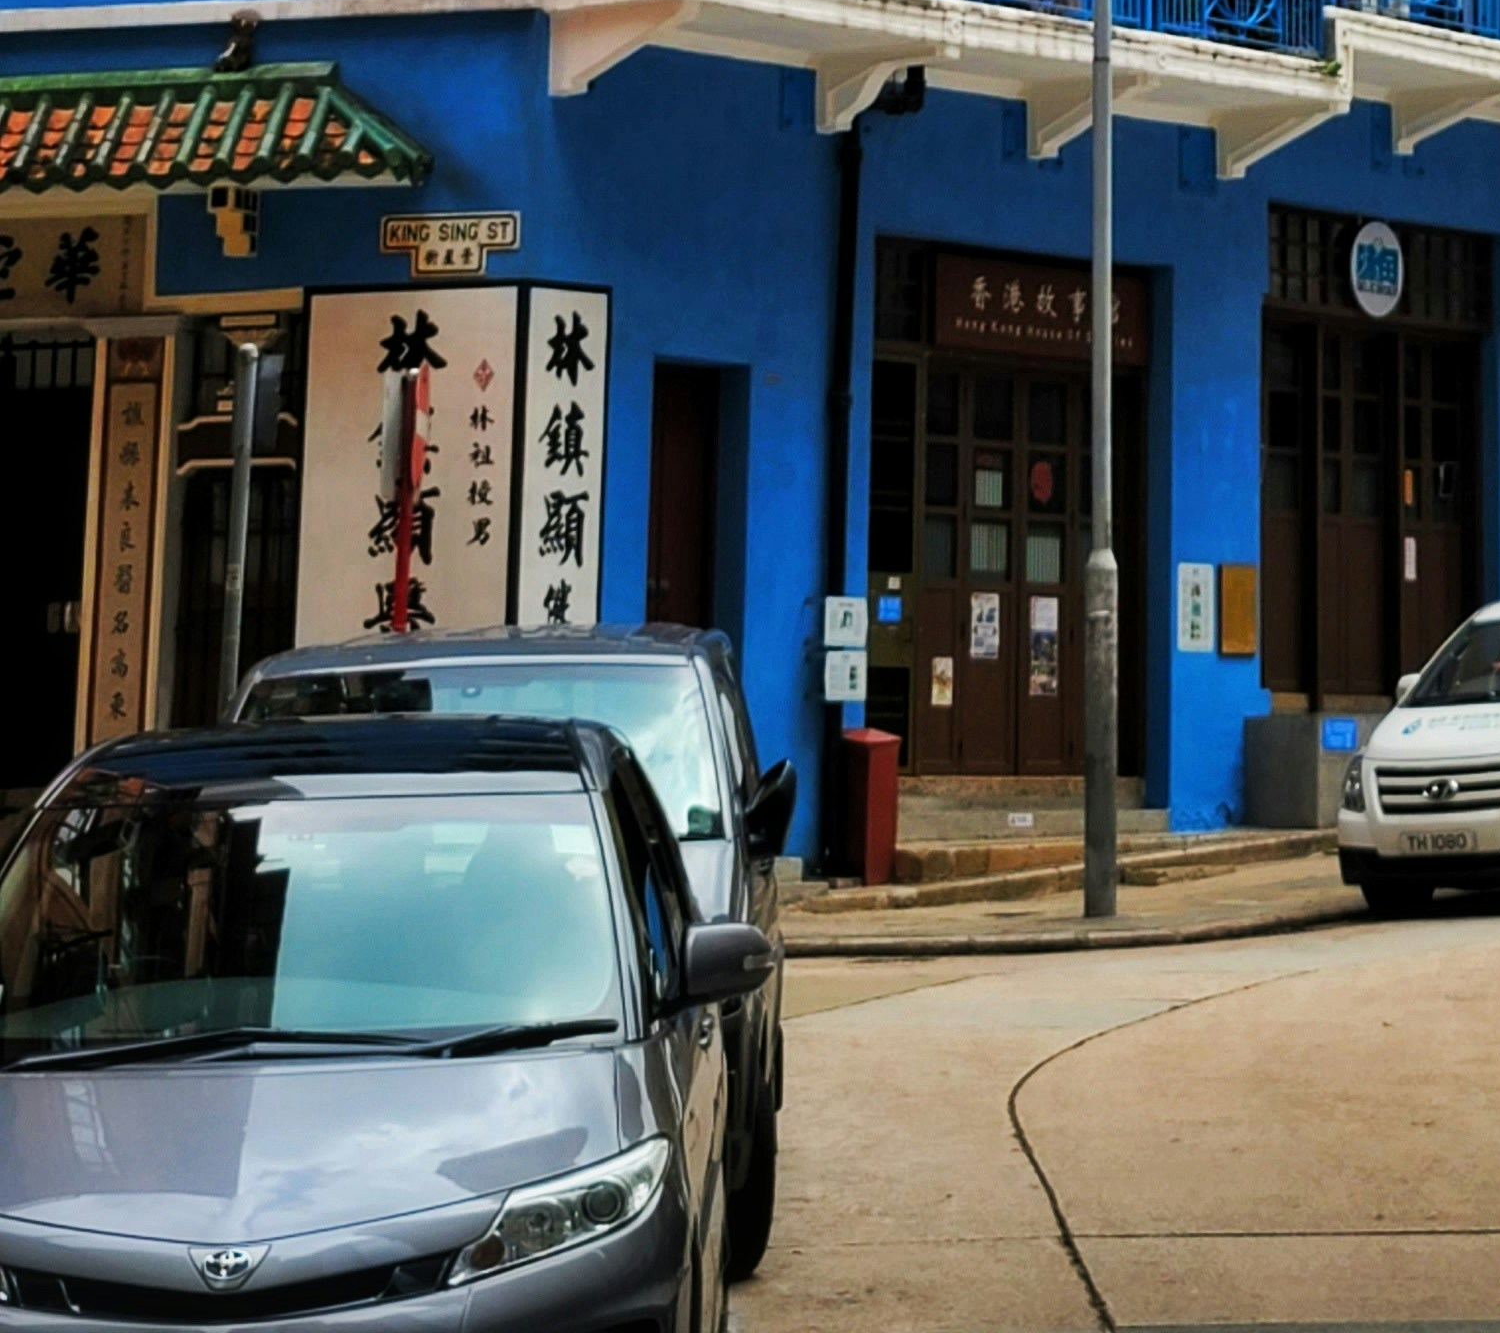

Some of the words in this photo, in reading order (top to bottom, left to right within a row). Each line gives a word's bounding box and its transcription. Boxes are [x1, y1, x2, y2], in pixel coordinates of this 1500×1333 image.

[388, 223, 430, 242] KING
[438, 221, 479, 241] SING
[487, 220, 511, 240] ST
[1407, 835, 1428, 851] TH
